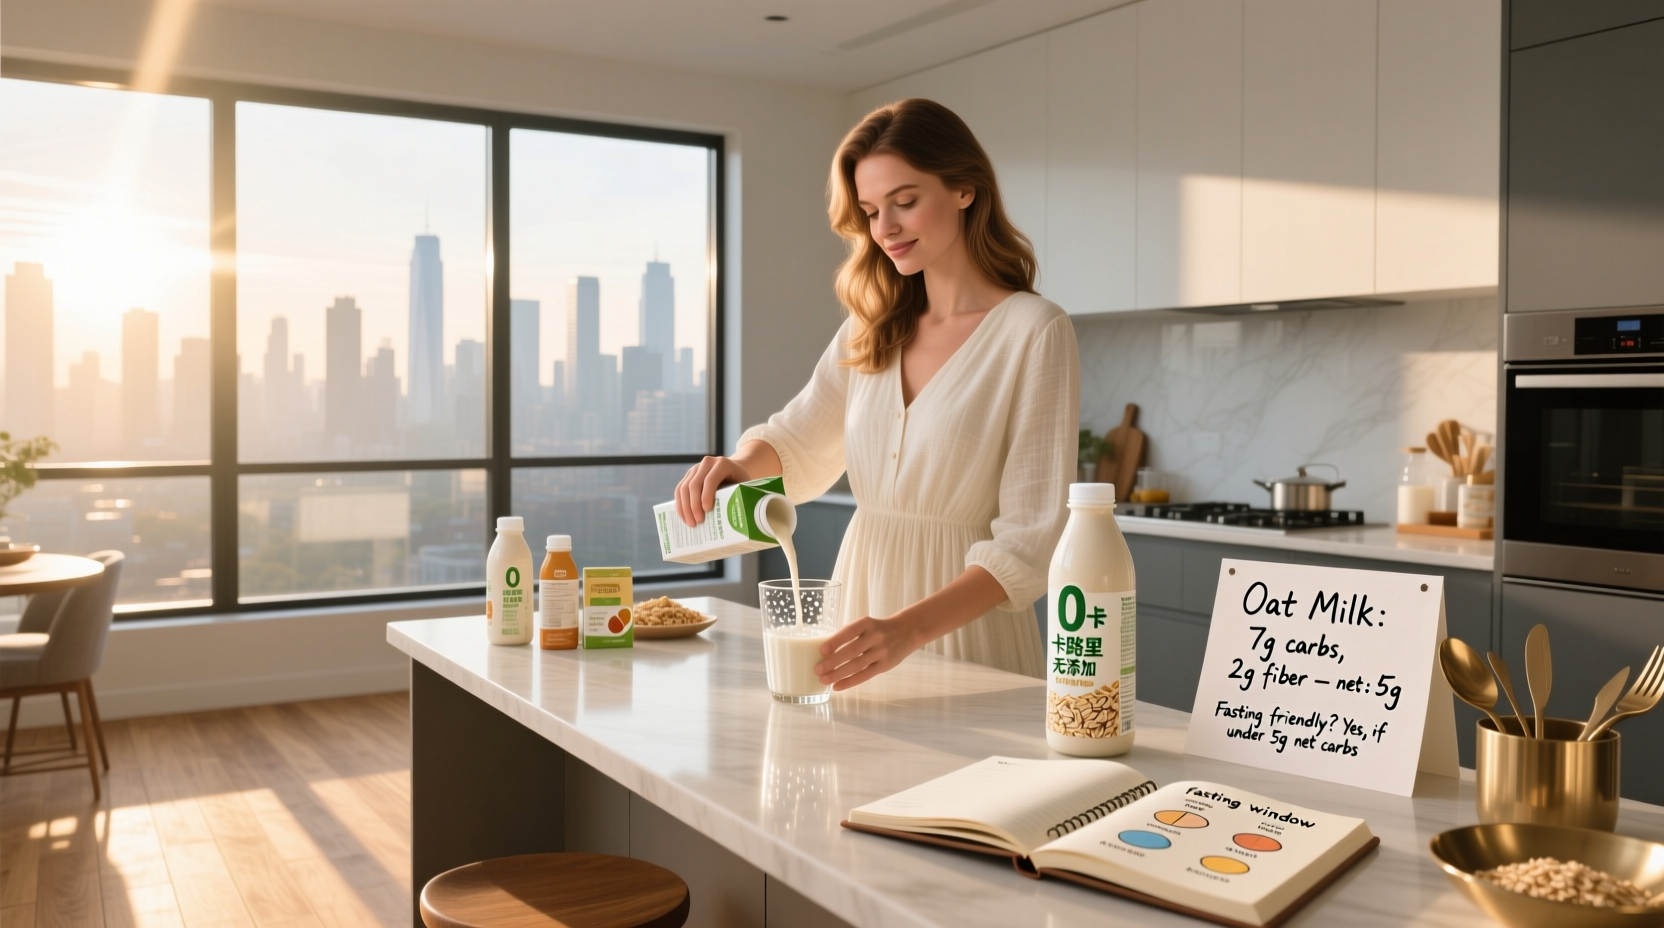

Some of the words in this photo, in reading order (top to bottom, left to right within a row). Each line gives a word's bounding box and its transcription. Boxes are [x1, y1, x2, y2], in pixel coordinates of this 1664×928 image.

[1242, 581, 1298, 618] Oat
[1308, 590, 1386, 627] Milk:
[1249, 626, 1276, 663] 7g
[1285, 633, 1345, 665] carbs,
[1053, 657, 1096, 676] 无添加
[1227, 657, 1255, 692] 2g
[1262, 662, 1309, 690] fiber
[1374, 673, 1402, 711] 5g
[1214, 700, 1263, 729] Fasting
[1269, 706, 1339, 738] friendly?
[1342, 716, 1368, 741] Yes,
[1372, 721, 1389, 744] if
[1226, 723, 1265, 742] under
[1269, 729, 1288, 754] 5g
[1293, 734, 1317, 750] net
[1320, 738, 1359, 757] carbs
[1249, 803, 1316, 829] window
